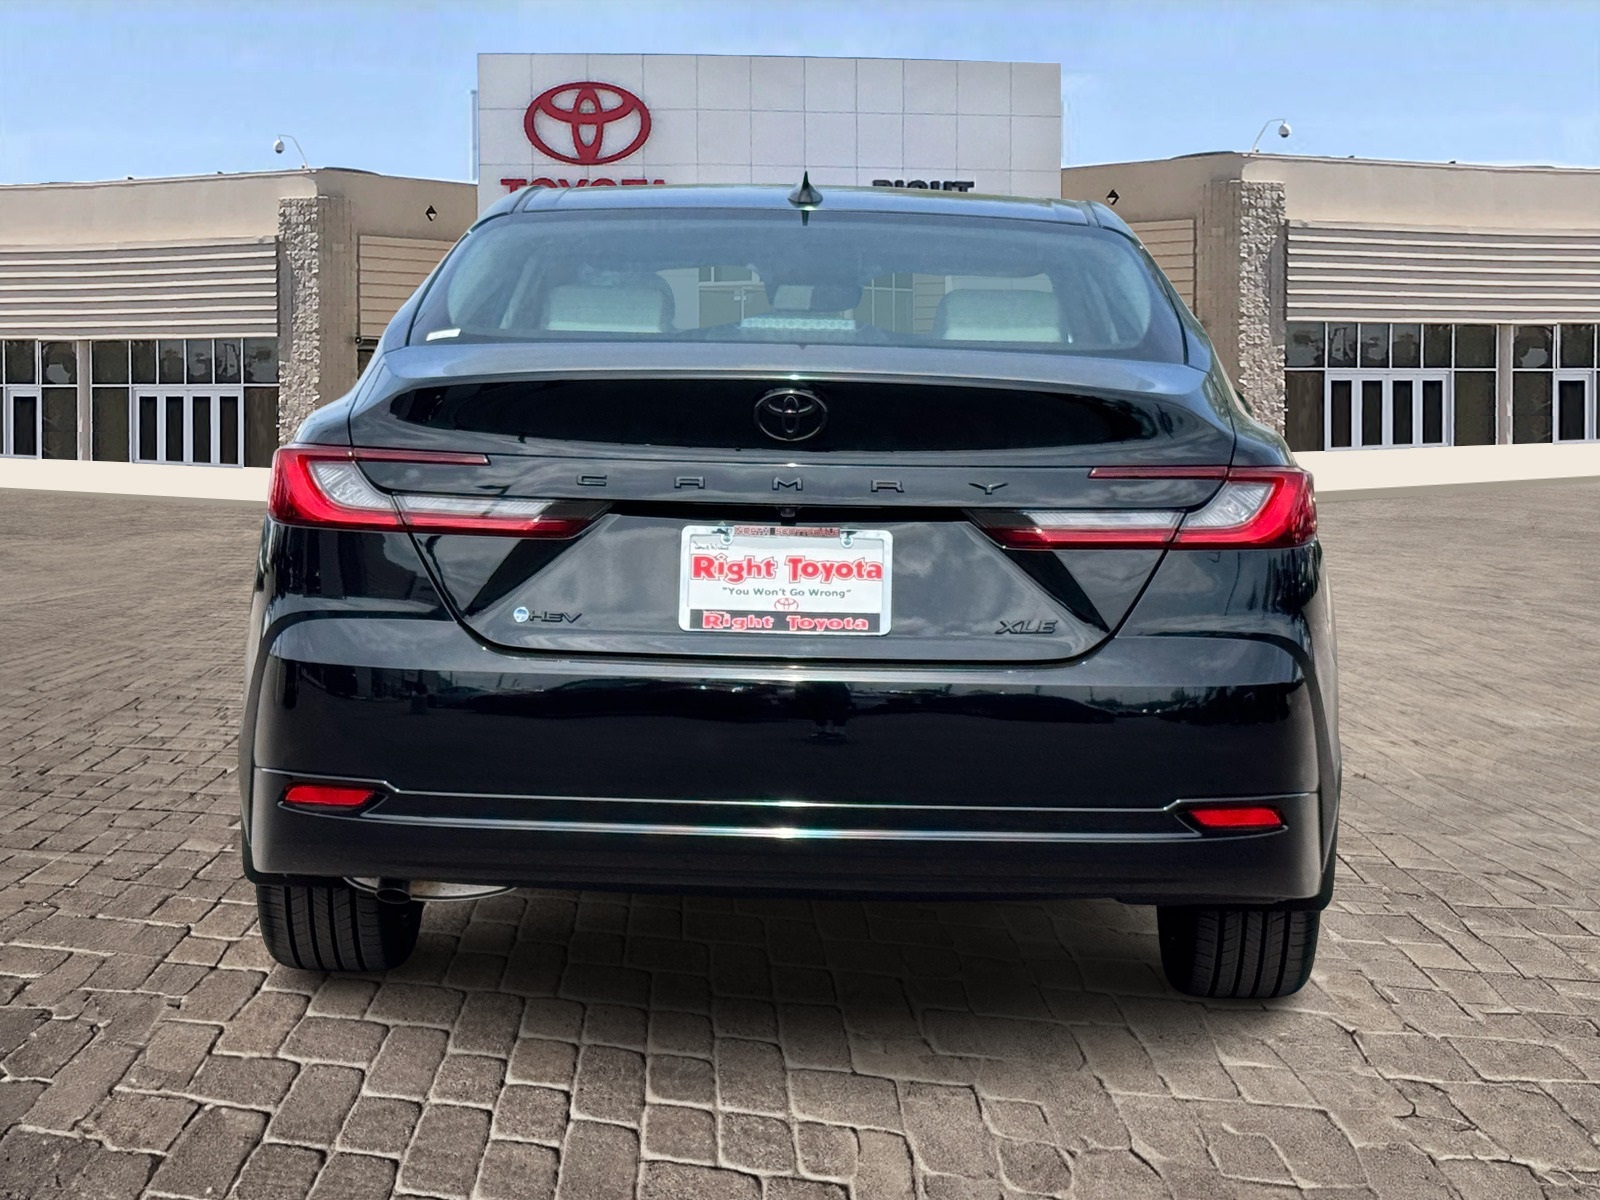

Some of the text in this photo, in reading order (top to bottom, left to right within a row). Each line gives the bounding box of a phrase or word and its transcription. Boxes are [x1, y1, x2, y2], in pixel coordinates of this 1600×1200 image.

[576, 473, 1009, 495] CAMRY
[692, 553, 883, 583] Right Toyota
[753, 588, 786, 597] Won't
[791, 588, 805, 597] Go
[702, 613, 869, 632] Right Toyota
[994, 620, 1059, 635] XLE
